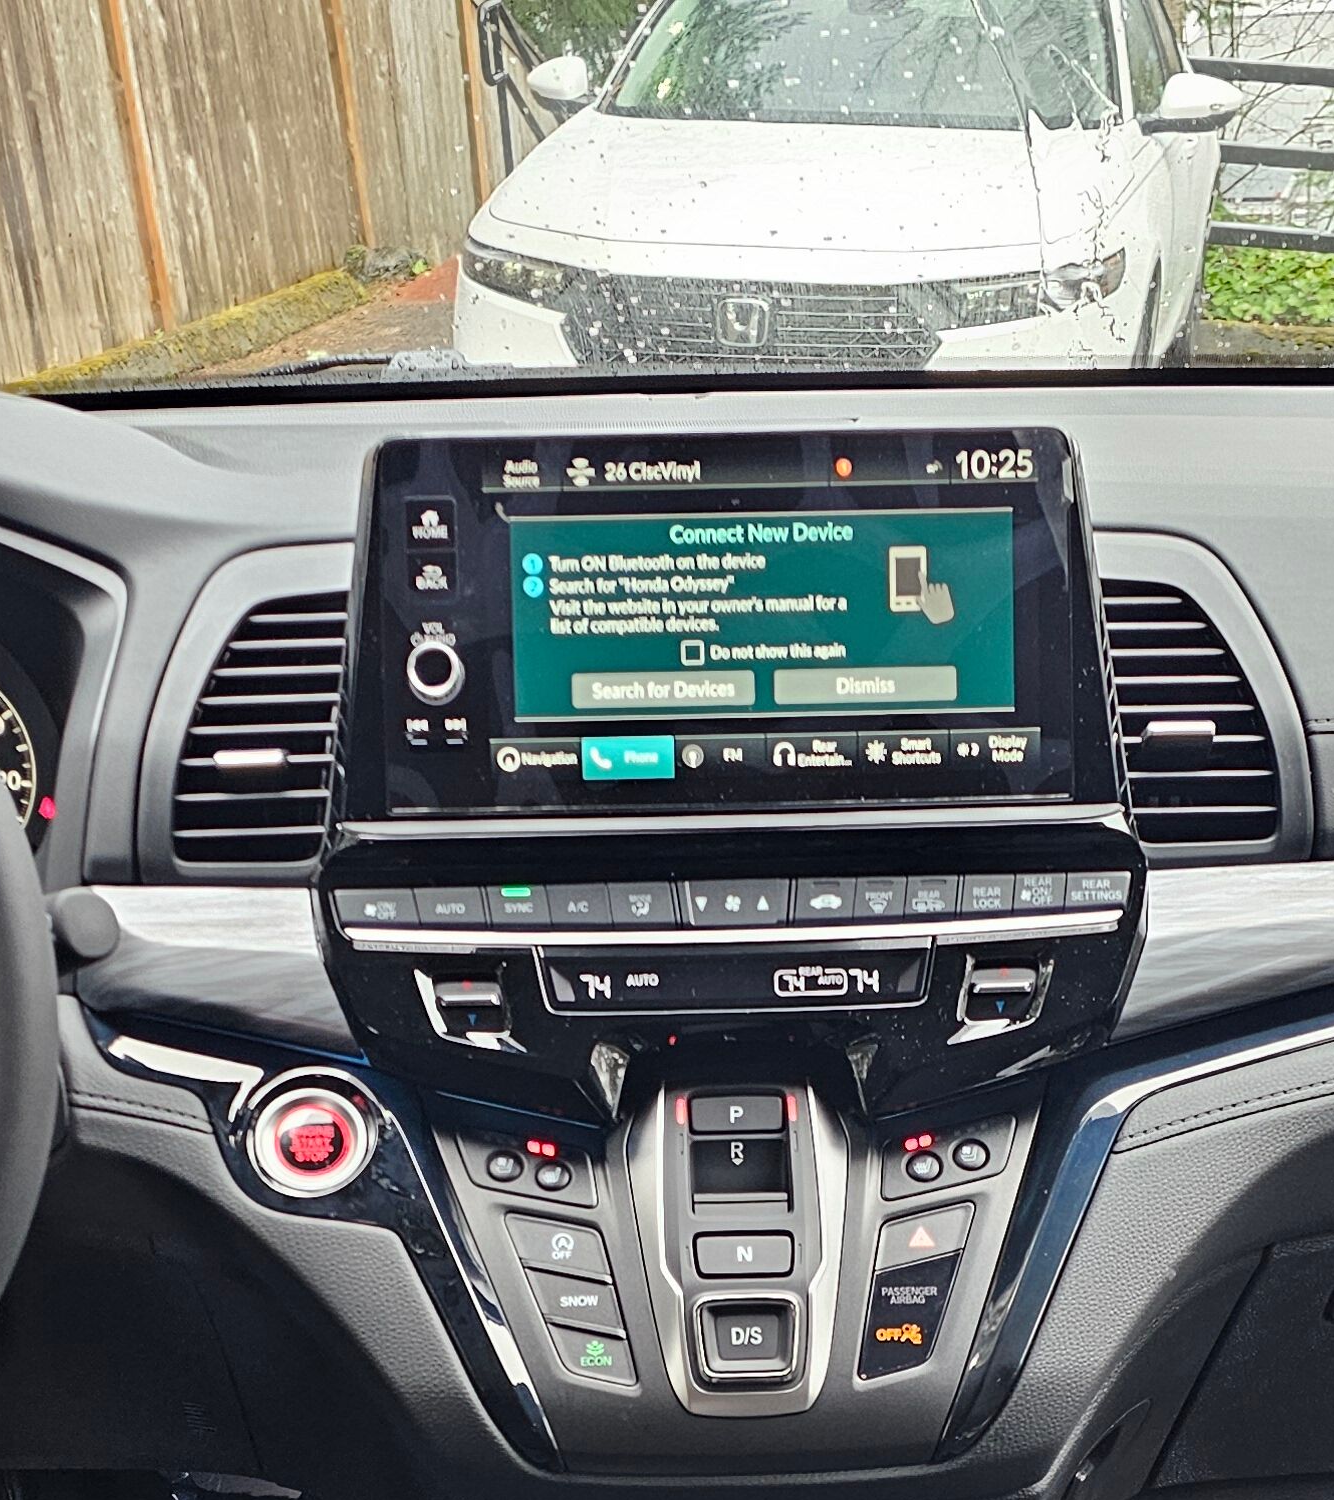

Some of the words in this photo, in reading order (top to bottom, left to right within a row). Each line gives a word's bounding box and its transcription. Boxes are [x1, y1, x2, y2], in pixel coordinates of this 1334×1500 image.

[504, 459, 538, 475] Audio
[604, 462, 628, 482] 26
[956, 449, 1034, 480] 10:25
[503, 474, 540, 489] Source
[412, 524, 449, 539] HOME
[669, 524, 745, 545] Connect
[747, 523, 789, 543] New
[793, 522, 854, 542] Device
[548, 555, 581, 573] Turn
[581, 555, 607, 572] ON
[608, 554, 675, 572] Bluetooth
[676, 556, 695, 570] on
[696, 553, 720, 570] the
[721, 553, 766, 570] device
[415, 575, 449, 590] BACK
[549, 577, 595, 595] Search
[596, 577, 618, 594] for
[618, 576, 669, 594] "Honda
[670, 575, 735, 594] Odyssey"
[549, 599, 581, 616] Visit
[583, 599, 606, 615] the
[607, 598, 660, 615] website
[662, 598, 676, 615] in
[679, 600, 709, 616] your
[711, 596, 763, 614] owner's
[765, 595, 814, 612] manual
[816, 595, 837, 611] for
[837, 597, 848, 611] a
[550, 617, 572, 635] list
[572, 617, 589, 634] of
[590, 616, 664, 635] compatible
[665, 616, 719, 632] devices.
[710, 644, 731, 660] Do
[731, 645, 753, 660] not
[755, 644, 788, 660] show
[789, 643, 812, 659] this
[814, 642, 846, 660] again
[592, 682, 644, 700] Search
[647, 681, 671, 699] for
[673, 680, 735, 699] Devices
[836, 676, 896, 695] Dismiss
[812, 740, 837, 753] Rear
[900, 737, 932, 751] Smart
[988, 735, 1028, 751] Display
[521, 751, 578, 767] Navigation
[624, 750, 658, 765] Phone
[723, 748, 743, 762] FM
[891, 751, 942, 765] Shortcuts
[992, 749, 1024, 763] Mode
[1023, 876, 1052, 888] REAR
[1082, 879, 1111, 890] REAR
[865, 891, 893, 900] FRONT
[972, 886, 1001, 899] REAR
[1071, 889, 1122, 902] SETTINGS
[435, 903, 465, 914] AUTO
[504, 902, 534, 914] SYNC
[567, 901, 589, 913] A/C
[973, 897, 1002, 909] LOCK
[798, 965, 823, 977] REAR
[578, 974, 612, 1000] 74
[625, 973, 660, 988] AUTO
[783, 974, 805, 992] 74
[817, 974, 843, 985] AUTO
[848, 968, 879, 993] 74
[729, 1105, 744, 1124] P
[730, 1142, 744, 1159] R
[552, 1250, 572, 1260] OFF
[736, 1246, 753, 1263] N
[881, 1286, 938, 1296] PASSENGER
[560, 1295, 598, 1307] SNOW
[889, 1295, 926, 1305] AIRBAG
[730, 1326, 763, 1346] D/S
[876, 1328, 902, 1341] OFF
[580, 1356, 612, 1367] ECON
